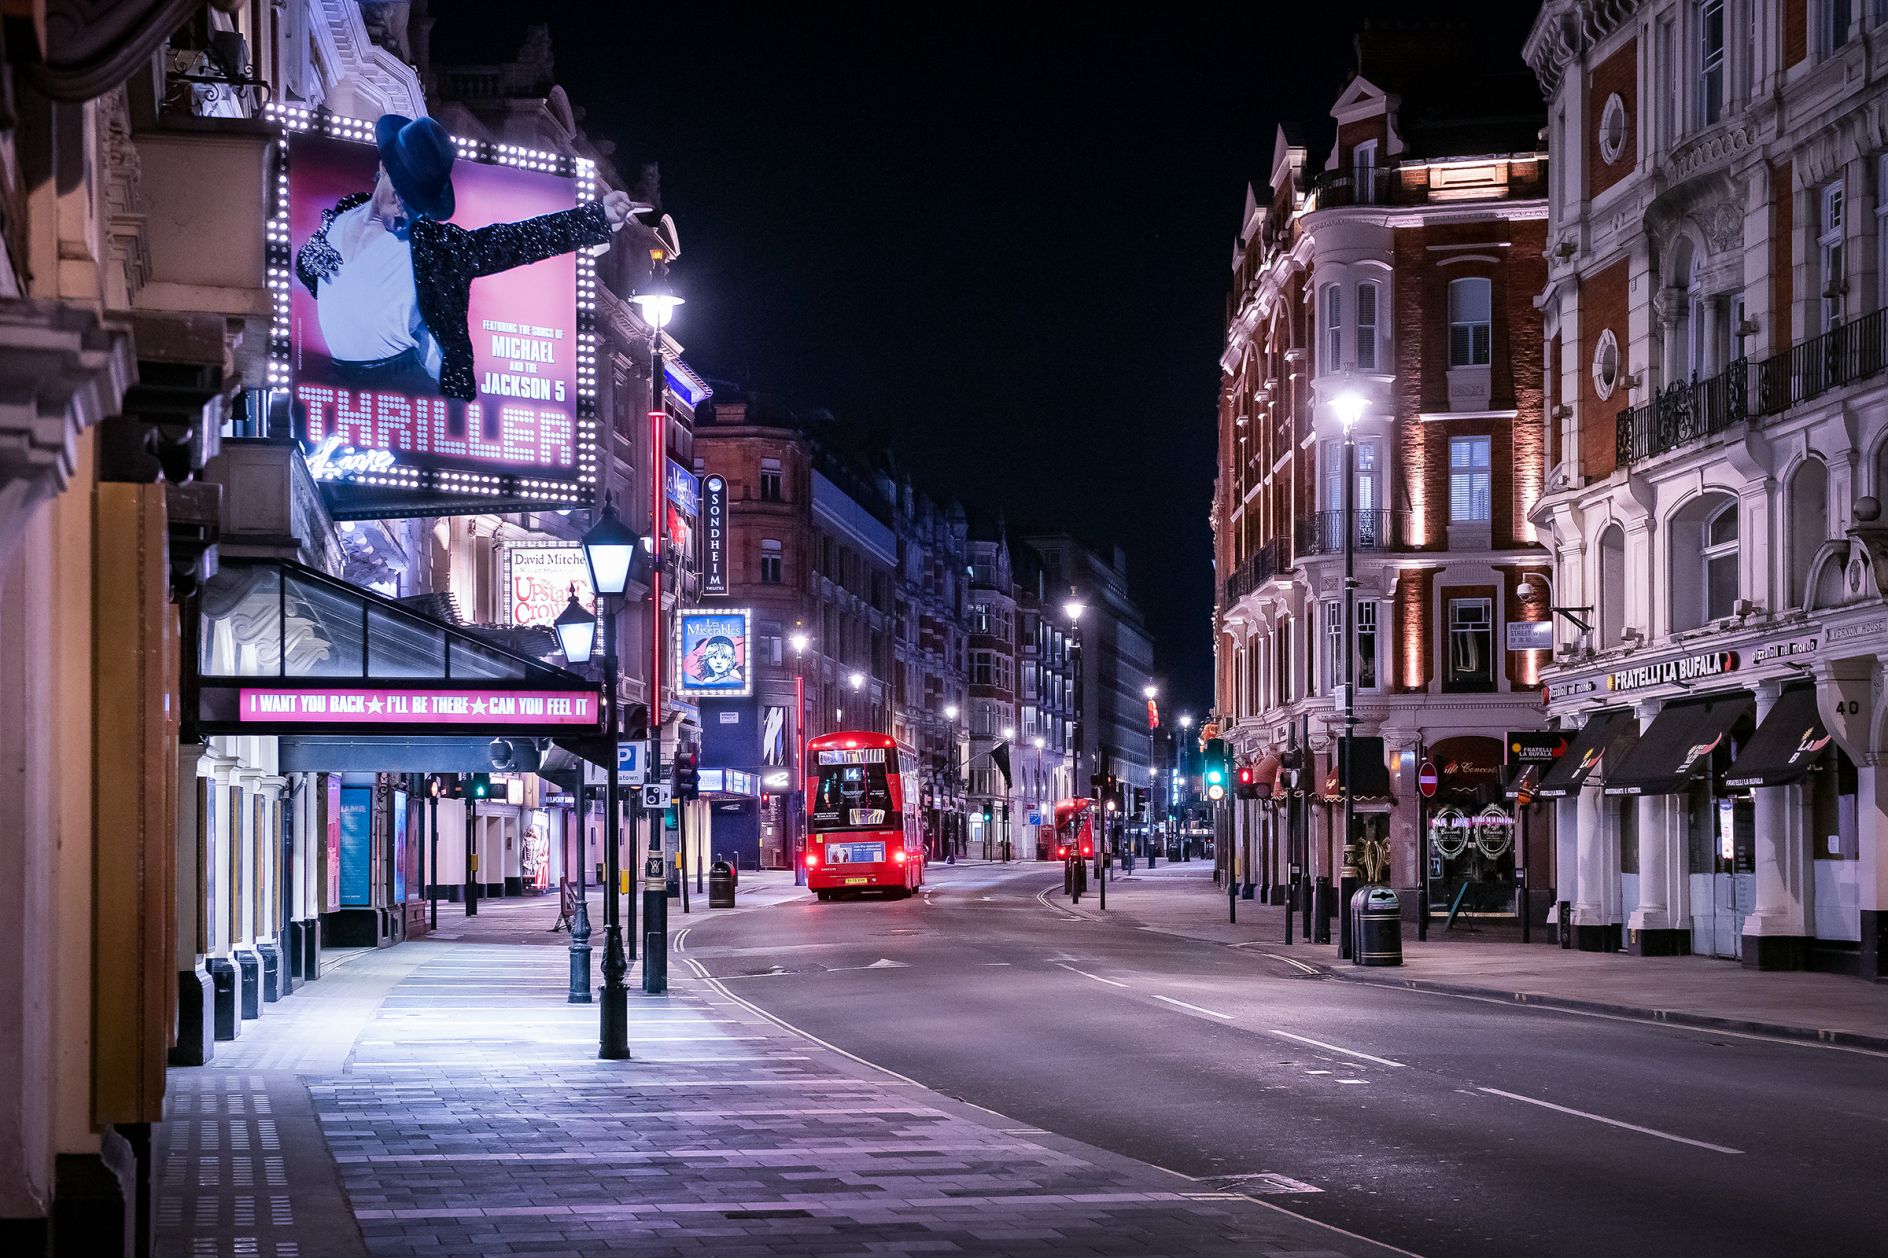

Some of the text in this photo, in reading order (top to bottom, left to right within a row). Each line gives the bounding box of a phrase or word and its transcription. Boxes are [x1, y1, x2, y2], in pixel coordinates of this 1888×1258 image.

[483, 319, 564, 339] FEATURING THE SONGS OF
[492, 334, 555, 365] MICHAEL
[509, 361, 538, 373] AND THE
[481, 372, 565, 402] JACKSON 5
[299, 386, 572, 465] THRILLER
[710, 493, 721, 585] SONDHEIM
[514, 553, 585, 565] David Mitche
[706, 618, 719, 627] Les
[1832, 620, 1884, 639] VERNON HOUSE
[1615, 652, 1721, 691] FRATELLI LA BUFALA
[250, 694, 588, 716] I WANT YOU BACK I'LL BE THERE CAN YOU FEEL IT
[1836, 700, 1859, 715] 40
[846, 769, 859, 780] 14
